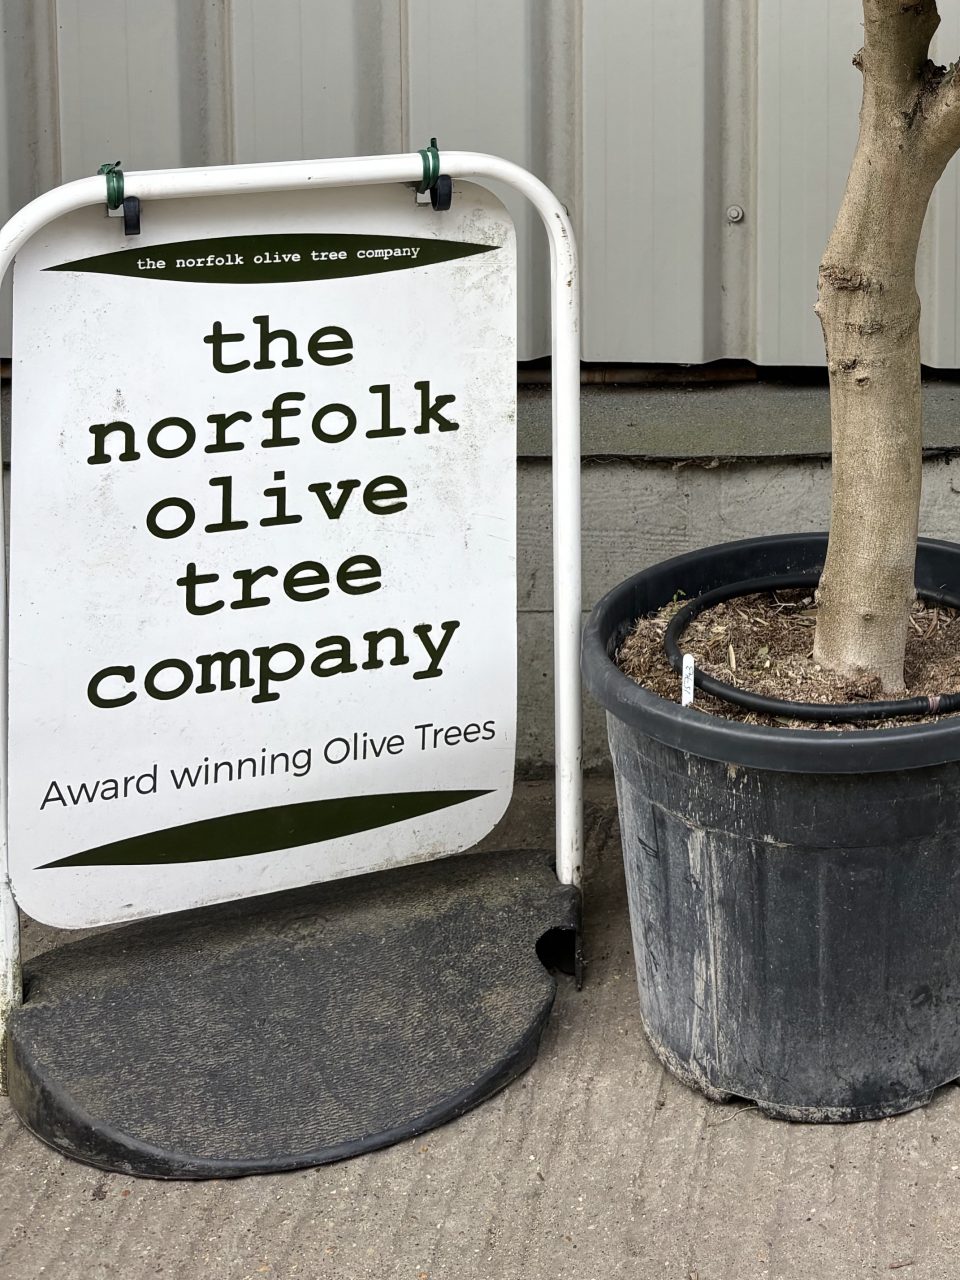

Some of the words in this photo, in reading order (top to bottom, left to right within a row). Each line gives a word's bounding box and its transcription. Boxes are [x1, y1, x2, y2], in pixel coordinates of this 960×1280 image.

[136, 257, 166, 270] the
[175, 253, 245, 269] norfolk
[253, 251, 302, 265] olive
[310, 249, 348, 261] tree
[356, 246, 421, 262] company
[203, 314, 354, 374] the
[87, 380, 460, 466] norfolk
[146, 470, 408, 540] olive
[176, 554, 382, 616] tree
[87, 620, 461, 709] company
[39, 764, 158, 811] Award
[170, 747, 312, 791] winning
[323, 732, 405, 765] Olive
[414, 720, 496, 751] Trees
